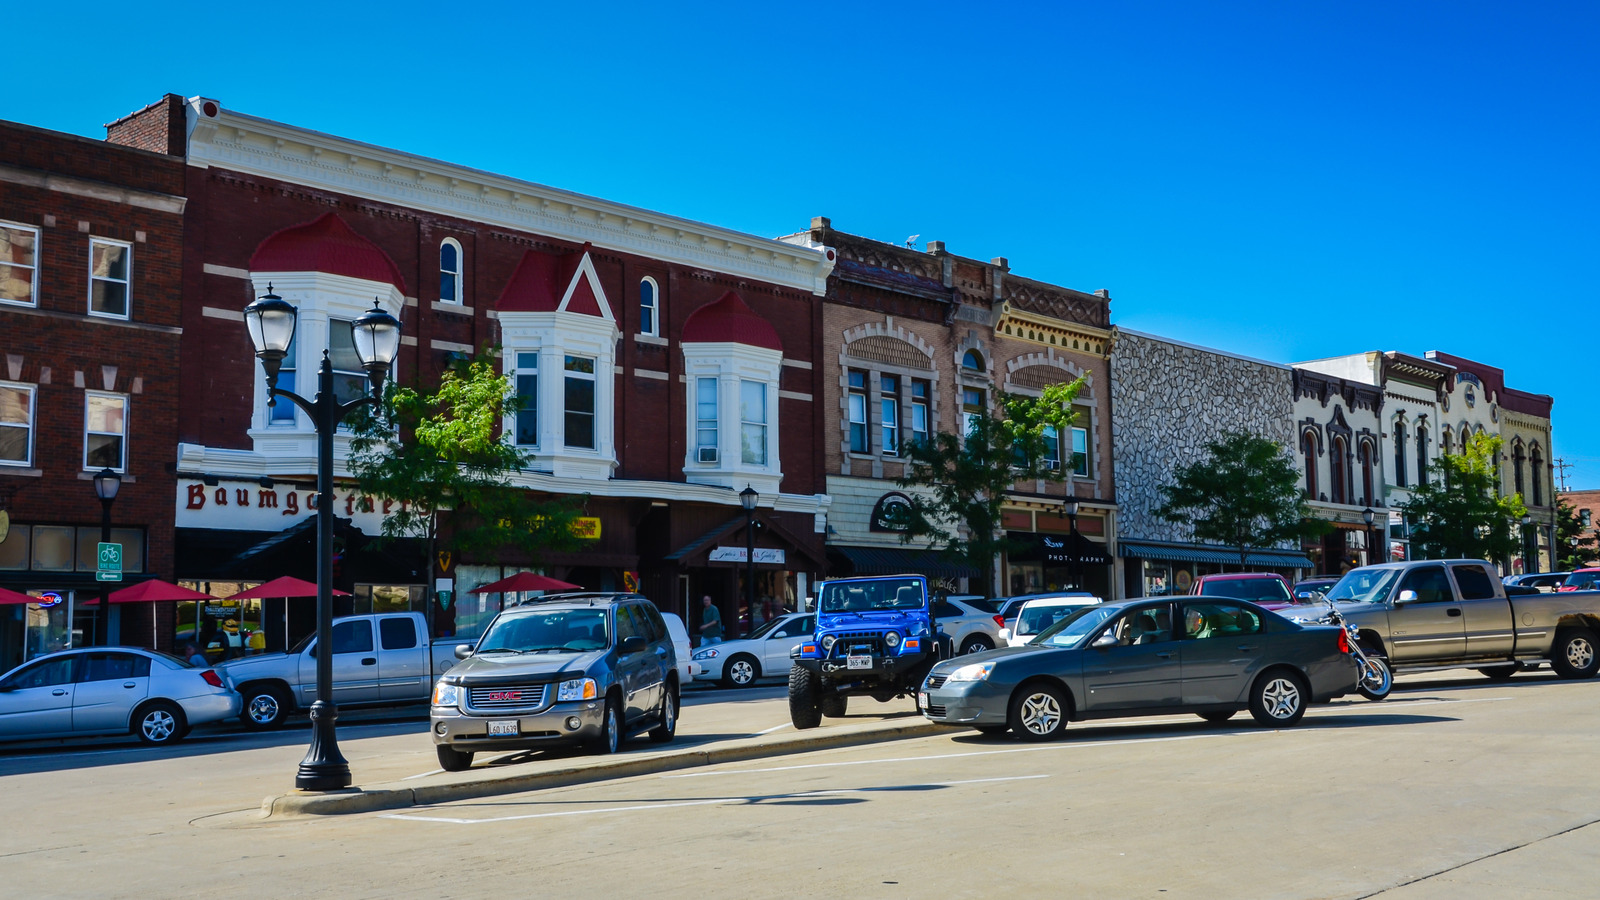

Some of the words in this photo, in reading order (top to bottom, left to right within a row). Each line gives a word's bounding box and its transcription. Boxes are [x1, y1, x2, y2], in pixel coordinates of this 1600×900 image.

[739, 551, 761, 559] BRAL
[1048, 554, 1106, 564] PHOTRAPHY
[489, 691, 522, 701] GMC
